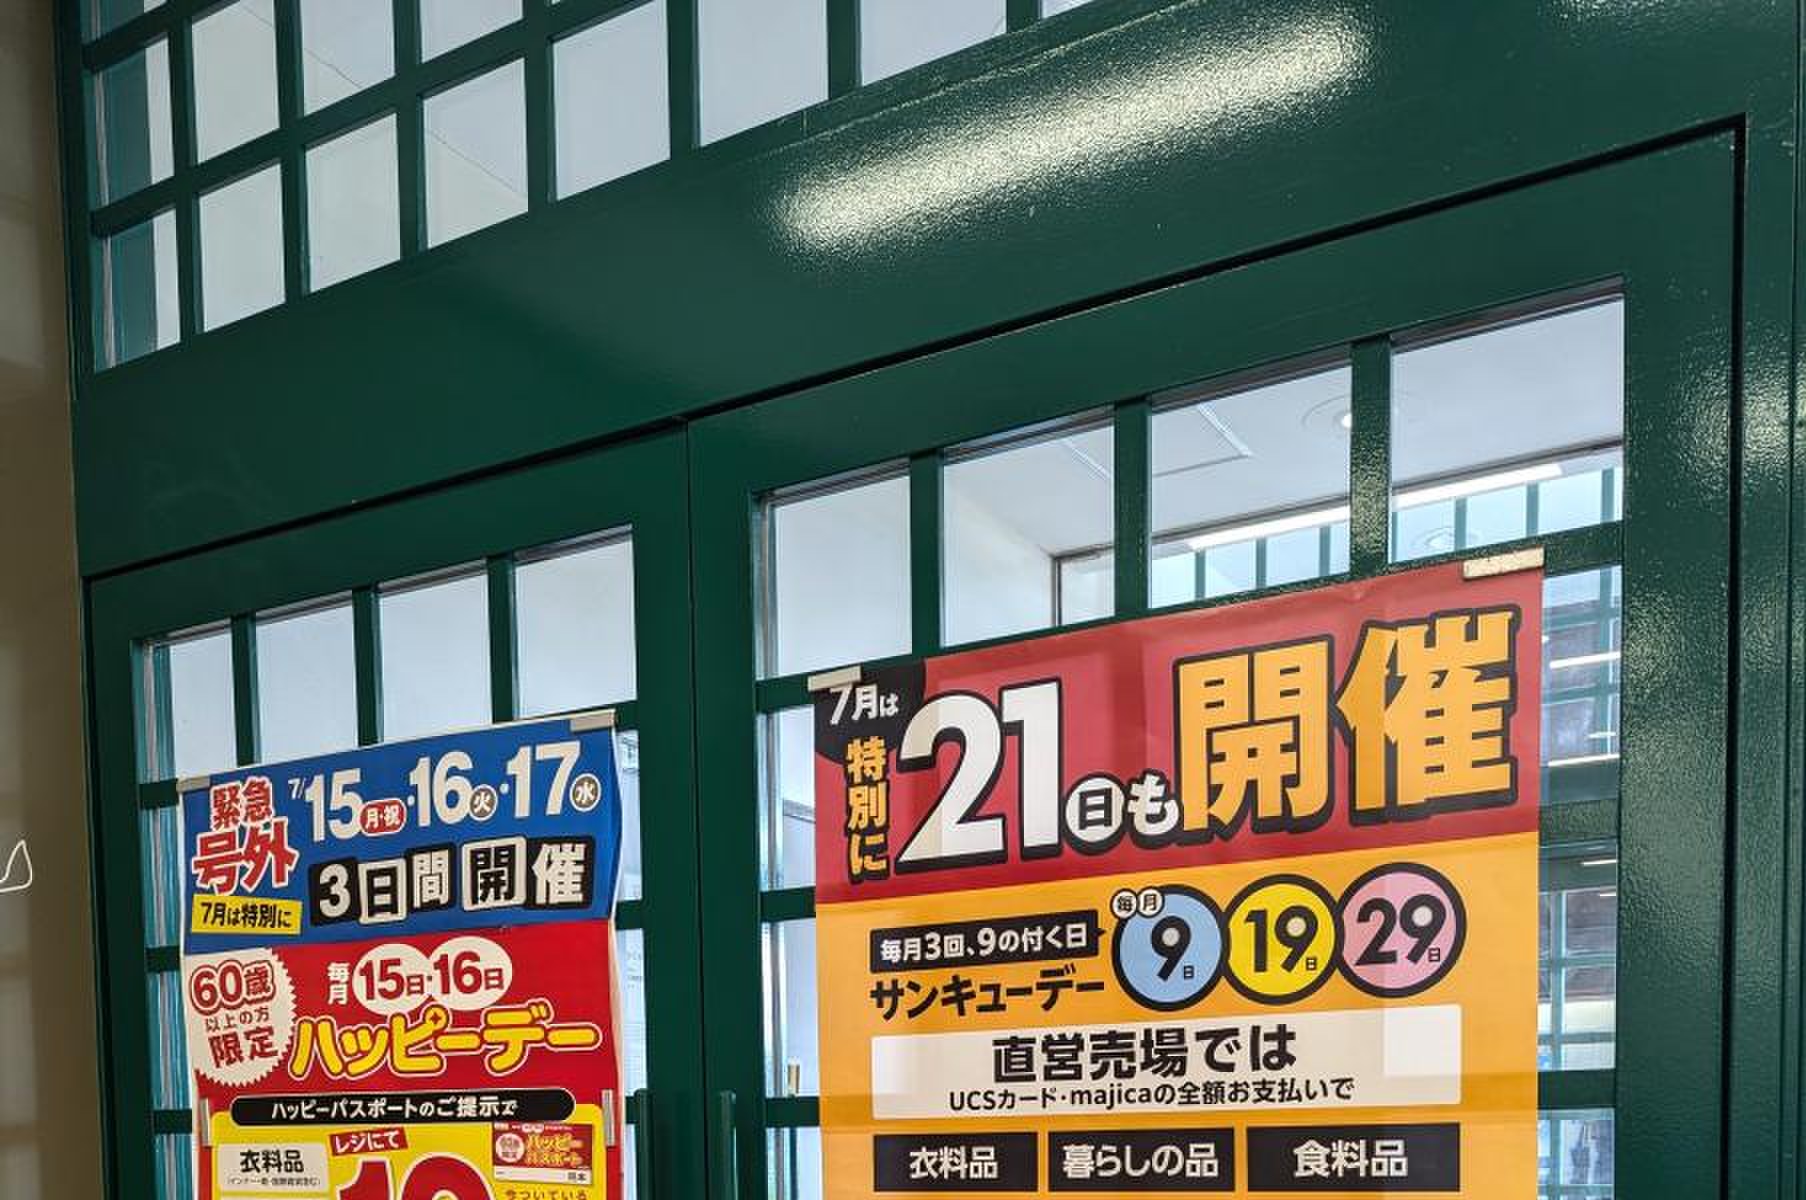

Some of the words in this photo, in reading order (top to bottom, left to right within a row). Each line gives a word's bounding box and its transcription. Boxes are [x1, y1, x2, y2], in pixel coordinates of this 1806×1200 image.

[829, 686, 899, 724] 7月は
[211, 777, 274, 830] 緊急
[846, 737, 888, 879] 特別に
[192, 817, 300, 895] 号外
[318, 842, 590, 921] 3日間開催
[200, 902, 292, 928] 7月は特別に
[1113, 891, 1161, 916] 毎月
[880, 922, 1088, 963] 毎月3回、9の付く日
[1244, 908, 1317, 974] 19日
[1356, 894, 1442, 967] 29日
[190, 960, 275, 1012] 60歳
[328, 962, 349, 1005] 毎月
[870, 965, 1105, 1021] サンキューデー
[206, 1007, 270, 1032] 以上の方
[290, 1002, 600, 1077] ハッピーデー
[211, 1026, 277, 1068] 限定
[993, 1023, 1297, 1083] 直営売場では
[272, 1096, 518, 1120] ハッピーパスポートのご提示で
[949, 1076, 1355, 1112] UCSカード・majicaの全額お支払いで
[240, 1149, 304, 1173] 衣料品
[335, 1132, 400, 1155] レジにて
[909, 1145, 998, 1181] 衣料品
[1062, 1143, 1219, 1180] 暮らしの品
[1293, 1139, 1409, 1179] 食料品
